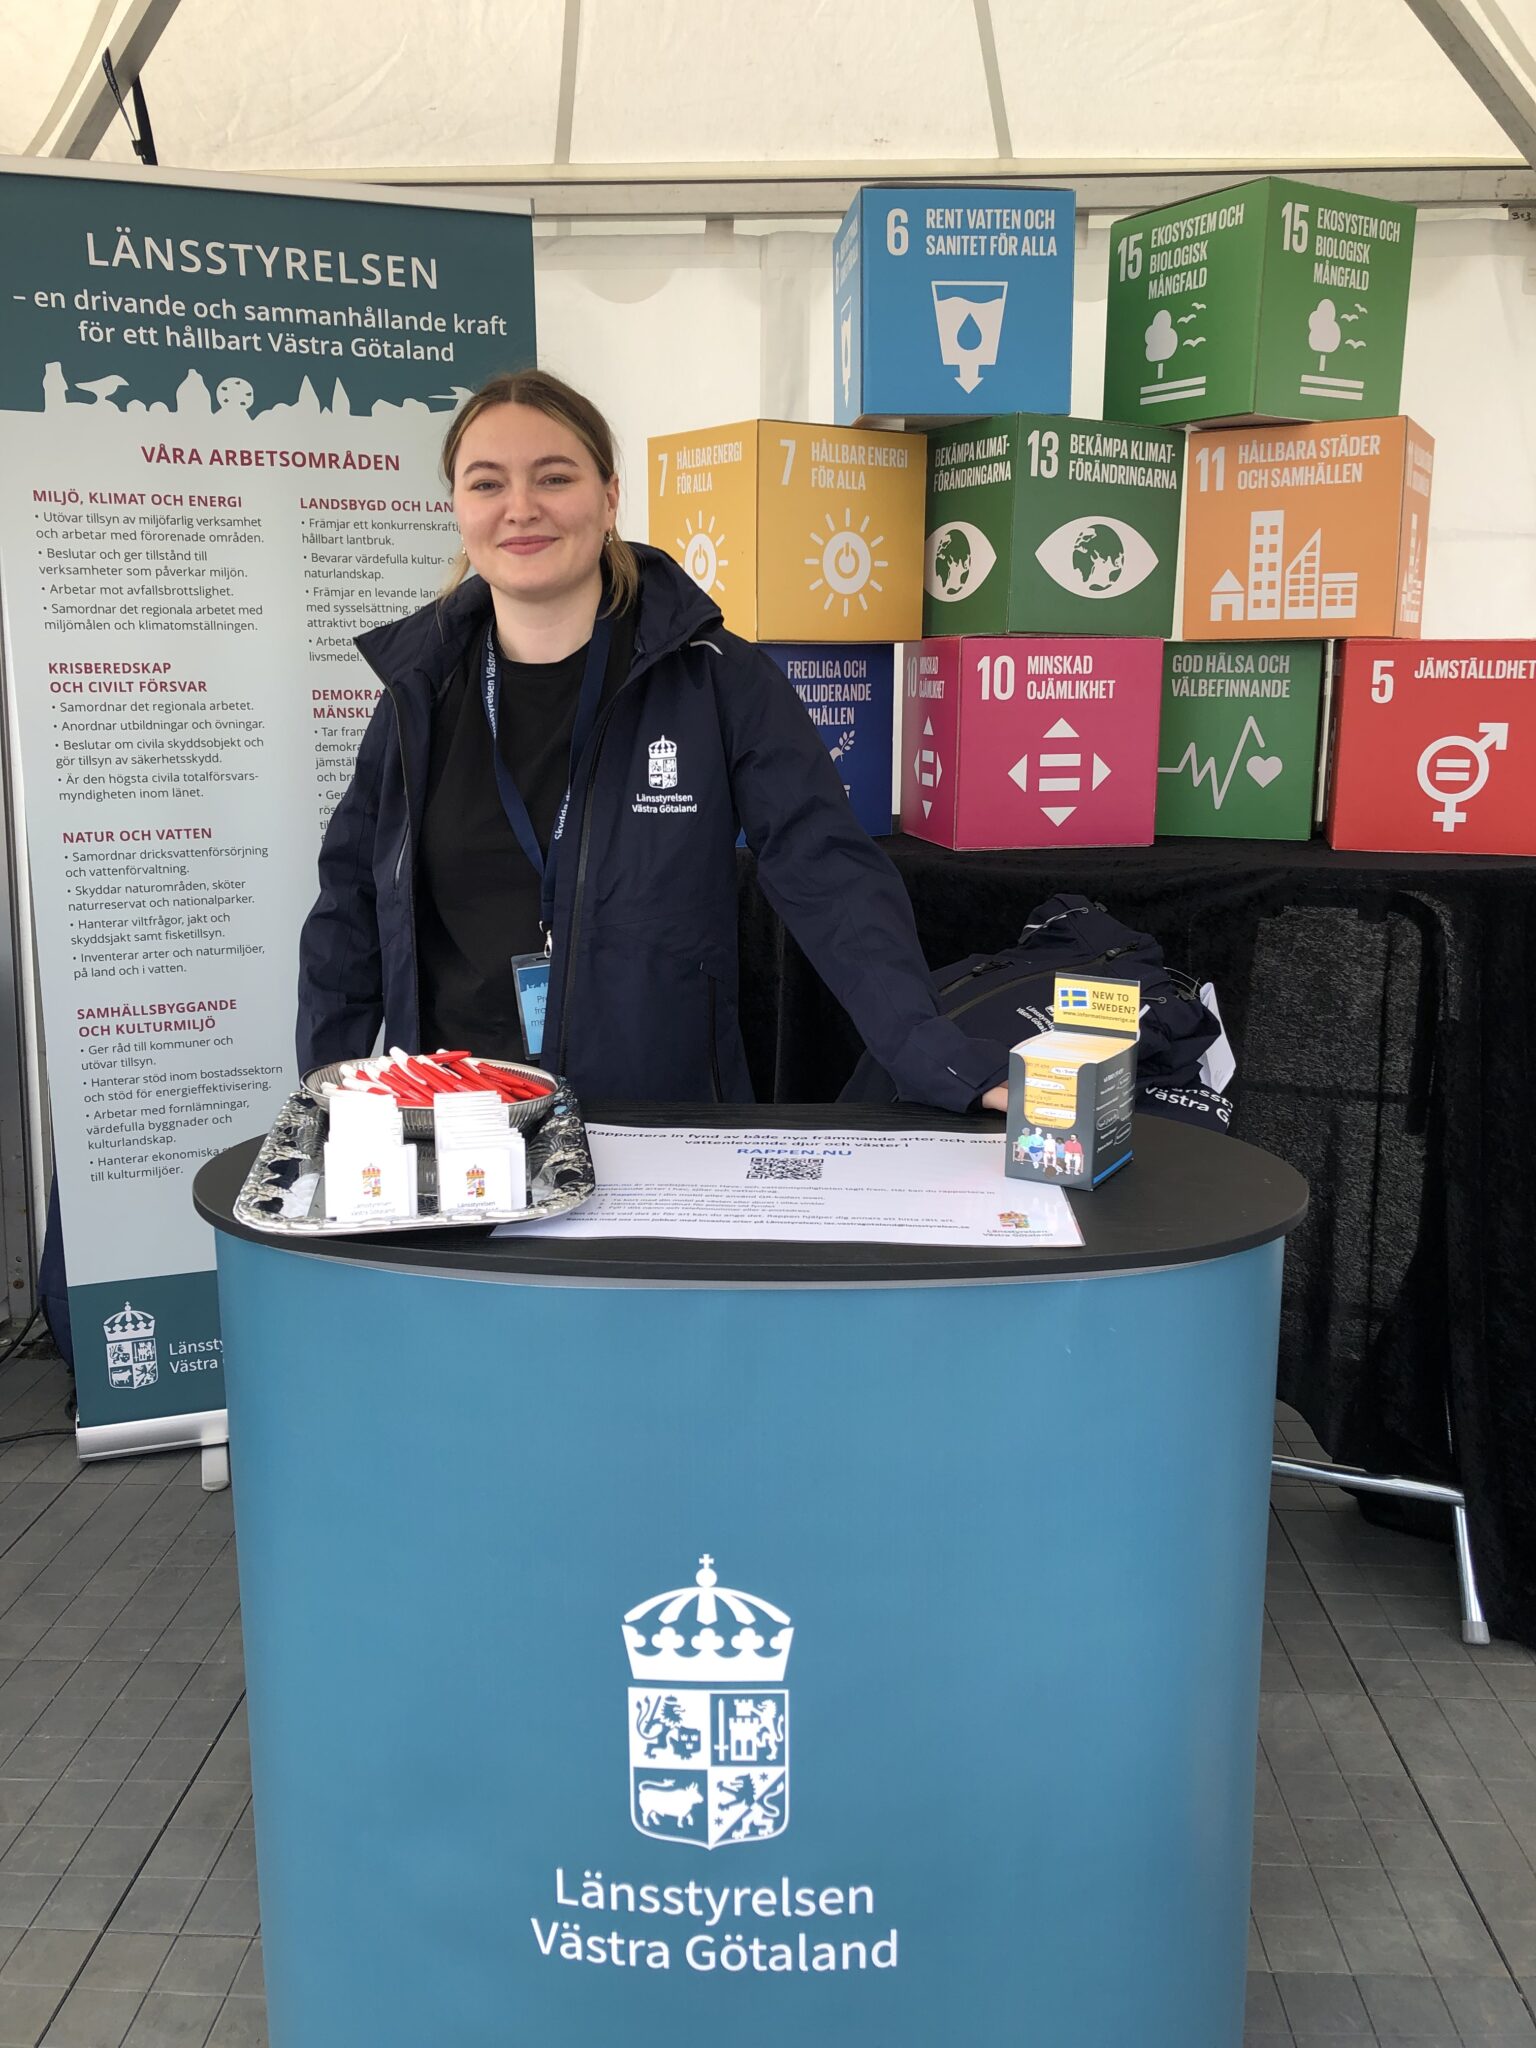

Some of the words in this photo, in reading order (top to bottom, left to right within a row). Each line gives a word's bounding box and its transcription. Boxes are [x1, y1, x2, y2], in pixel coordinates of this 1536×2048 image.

[885, 207, 909, 256] 6
[925, 208, 964, 230] RENT
[966, 208, 1022, 230] VATTEN
[1024, 209, 1056, 230] OCH
[1281, 201, 1310, 254] 15
[1317, 207, 1379, 239] EKOSYSTEM
[1379, 221, 1401, 243] OCH
[925, 235, 987, 257] SANITET
[989, 232, 1019, 257] FÖR
[1021, 235, 1058, 257] ALLA
[1117, 232, 1144, 282] 15
[1151, 212, 1218, 249] EKOSYSTEM
[1218, 203, 1245, 230] OCH
[1315, 235, 1371, 265] BIOLOGISK
[85, 226, 439, 290] LÄNSSTYRELSEN
[1149, 240, 1209, 274] BIOLOGISK
[1148, 267, 1207, 300] MÅNGFALD
[1313, 262, 1370, 291] MÅNGFALD
[34, 291, 66, 310] en
[73, 288, 186, 318] drivande
[192, 299, 238, 321] och
[243, 305, 448, 333] sammanhållande
[453, 314, 508, 337] kraft
[77, 319, 115, 343] för
[122, 326, 159, 346] ett
[166, 324, 262, 353] hållbart
[266, 333, 344, 357] Västra
[350, 337, 455, 362] Götaland
[140, 445, 203, 465] VÅRA
[208, 447, 401, 472] ARBETSOMRÅDEN
[779, 439, 797, 486] 7
[811, 438, 865, 466] HÅLLBAR
[867, 446, 908, 469] ENERGI
[935, 440, 974, 468] BEKÄMPA
[973, 435, 1011, 460] KLIMAT-
[1026, 430, 1061, 479] 13
[1069, 432, 1129, 461] BEKÄMPA
[1130, 438, 1176, 462] KLIMAT-
[658, 453, 668, 497] 7
[676, 443, 712, 469] HÅLLBAR
[712, 440, 742, 465] ENERGI
[1194, 446, 1226, 492] 11
[1238, 440, 1317, 465] HÅLLBARA
[1318, 434, 1381, 459] STÄDER
[676, 474, 694, 495] FÖR
[692, 472, 713, 494] ALLA
[811, 464, 835, 489] FÖR
[837, 469, 867, 491] ALLA
[933, 461, 1012, 494] FÖRÄNDRINGARNA
[1068, 462, 1178, 491] FÖRÄNDRINGARNA
[1237, 467, 1270, 490] OCH
[1271, 461, 1363, 488] SAMHÄLLEN
[32, 488, 84, 506] MILJÖ,
[88, 492, 146, 505] KLIMAT
[150, 494, 184, 507] OCH
[188, 495, 242, 508] ENERGI
[300, 497, 387, 511] LANDSBYGD
[391, 500, 421, 512] OCH
[43, 512, 83, 524] Utövar
[86, 513, 120, 527] tillsyn
[122, 514, 136, 524] av
[138, 514, 194, 529] miljöfarlig
[195, 516, 262, 527] verksamhet
[309, 518, 351, 531] Främjar
[353, 520, 369, 530] ett
[302, 533, 344, 545] hållbart
[346, 534, 395, 545] lantbruk.
[311, 553, 352, 563] Bevarar
[355, 553, 408, 564] värdefulla
[411, 555, 445, 565] kultur-
[38, 565, 123, 576] verksamheter
[126, 567, 151, 577] som
[155, 565, 206, 579] påverkar
[209, 566, 248, 580] miljön.
[304, 568, 384, 580] naturlandskap.
[49, 584, 96, 596] Arbetar
[99, 586, 124, 596] mot
[126, 585, 234, 599] avfallsbrottslighet.
[306, 603, 330, 612] med
[333, 602, 412, 615] sysselsättning,
[307, 618, 357, 628] attraktivt
[309, 651, 363, 662] livsmedel.
[1172, 655, 1204, 673] GOD
[1205, 651, 1255, 674] HÄLSA
[1257, 655, 1291, 674] OCH
[48, 662, 172, 674] KRISBEREDSKAP
[787, 660, 841, 679] FREDLIGA
[843, 660, 867, 678] OCH
[907, 656, 917, 698] 10
[976, 655, 1015, 700] 10
[1027, 655, 1093, 675] MINSKAD
[49, 681, 84, 693] OCH
[88, 681, 134, 693] CIVILT
[139, 678, 208, 693] FÖRSVAR
[1026, 680, 1115, 700] OJÄMLIKHET
[1171, 676, 1291, 698] VÄLBEFINNANDE
[1371, 660, 1395, 704] 5
[1413, 657, 1536, 680] JÄMSTÄLLDHET
[66, 773, 80, 785] Är
[83, 773, 106, 784] den
[108, 773, 149, 786] högsta
[151, 772, 180, 783] civila
[183, 771, 259, 782] totalförsvars-
[631, 804, 658, 814] Västra
[659, 803, 698, 814] Götaland
[636, 792, 693, 804] Länsstyrelsen
[62, 831, 114, 843] NATUR
[119, 829, 152, 842] OCH
[155, 827, 213, 840] VATTEN
[68, 899, 147, 911] naturreservat
[149, 897, 170, 908] och
[172, 893, 255, 907] nationalparker.
[1092, 990, 1115, 1000] NEW
[1117, 993, 1129, 1003] TO
[77, 999, 237, 1020] SAMHÄLLSBYGGANDE
[1092, 1002, 1136, 1015] SWEDEN?
[78, 1024, 111, 1038] OCH
[115, 1015, 216, 1035] KULTURMILJÖ
[86, 1122, 145, 1135] värdefulla
[148, 1117, 209, 1133] byggnader
[212, 1114, 233, 1125] och
[587, 1129, 667, 1138] Rapportera
[88, 1134, 176, 1150] kulturlandskap.
[737, 1148, 852, 1156] RAPPEN.NU
[90, 1171, 105, 1182] till
[107, 1165, 184, 1181] kulturmiljöer.
[169, 1358, 218, 1374] Västra
[555, 1867, 874, 1926] Länsstyrelsen
[530, 1917, 671, 1970] Västra
[684, 1928, 899, 1972] Götaland
